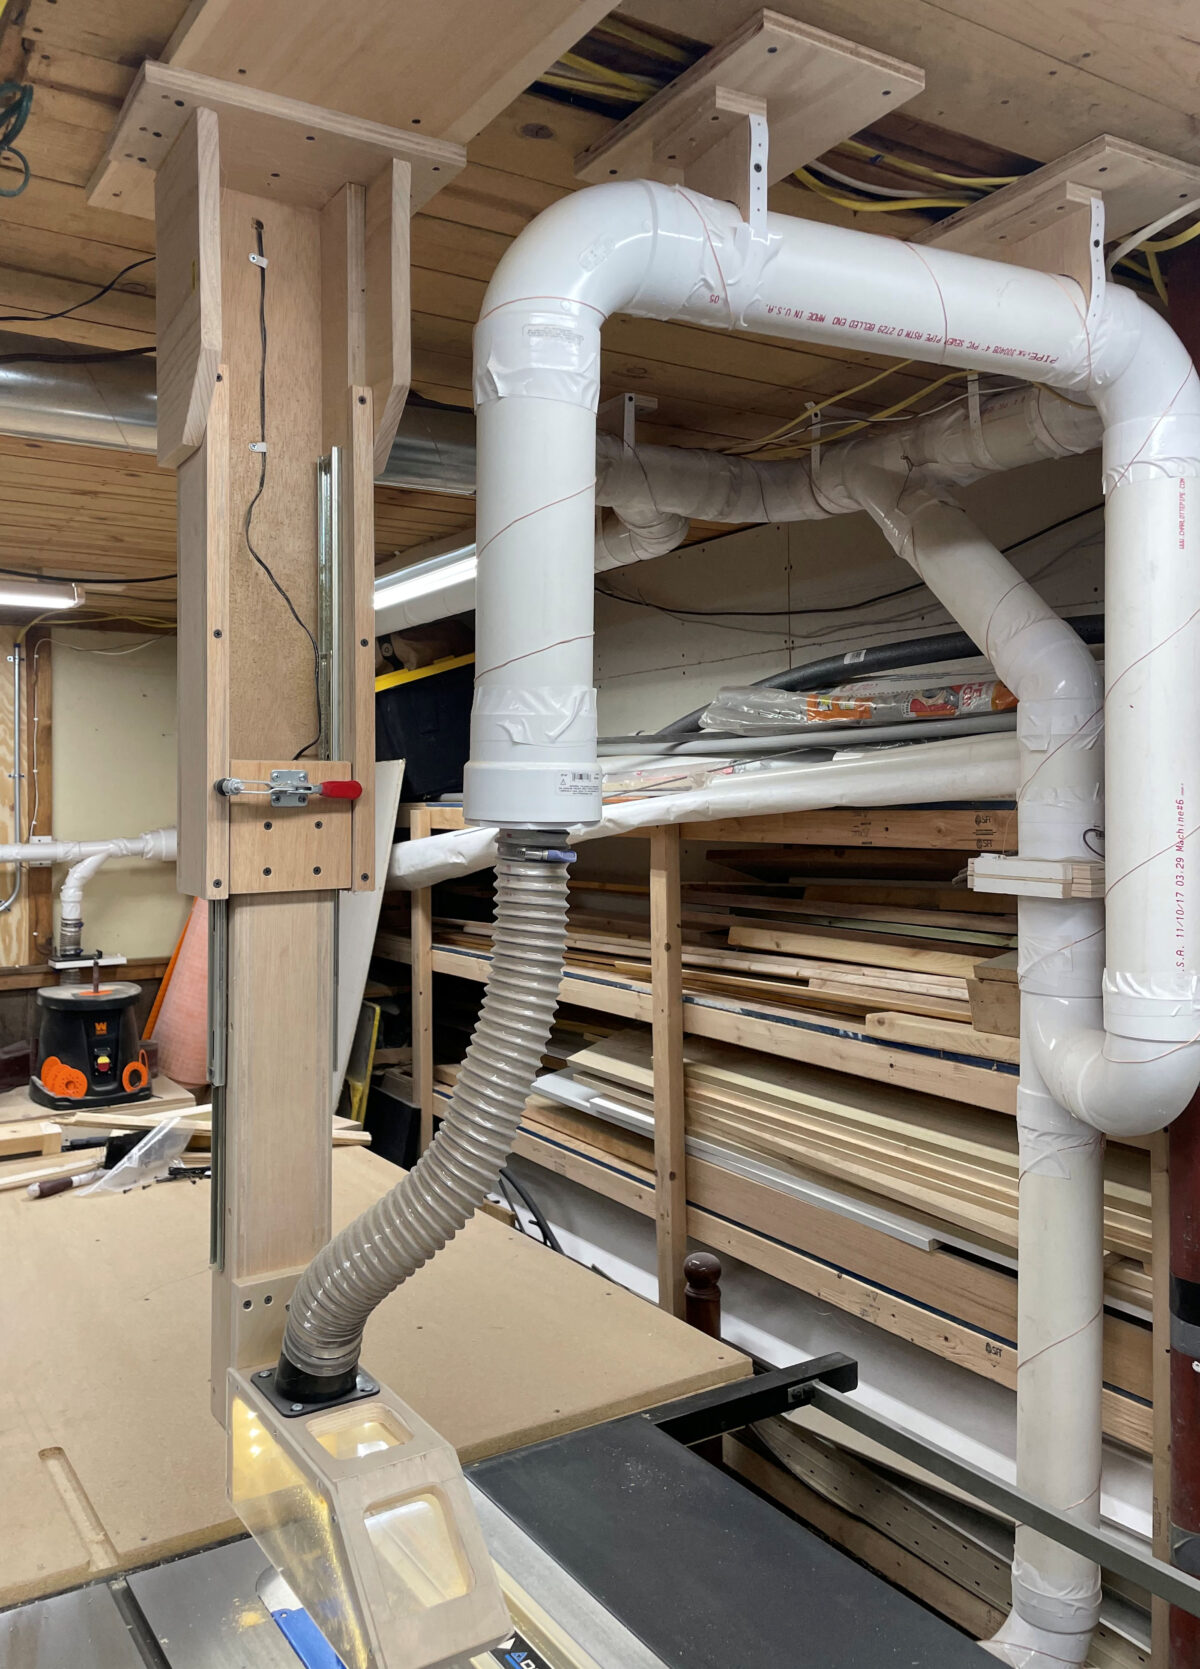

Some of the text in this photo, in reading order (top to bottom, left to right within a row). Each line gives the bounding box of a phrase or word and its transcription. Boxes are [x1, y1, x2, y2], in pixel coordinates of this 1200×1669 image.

[766, 304, 792, 317] U.S.A.
[793, 309, 804, 320] IN
[806, 311, 826, 323] MADE
[832, 316, 847, 327] END
[849, 319, 876, 332] BELLED
[877, 325, 896, 336] 2729
[905, 331, 924, 341] ASTM
[925, 333, 943, 344] PIPE
[944, 337, 965, 348] SEWER
[966, 341, 980, 351] PVC
[1175, 799, 1185, 852] Machine#6
[1175, 891, 1185, 938] 11/10/17
